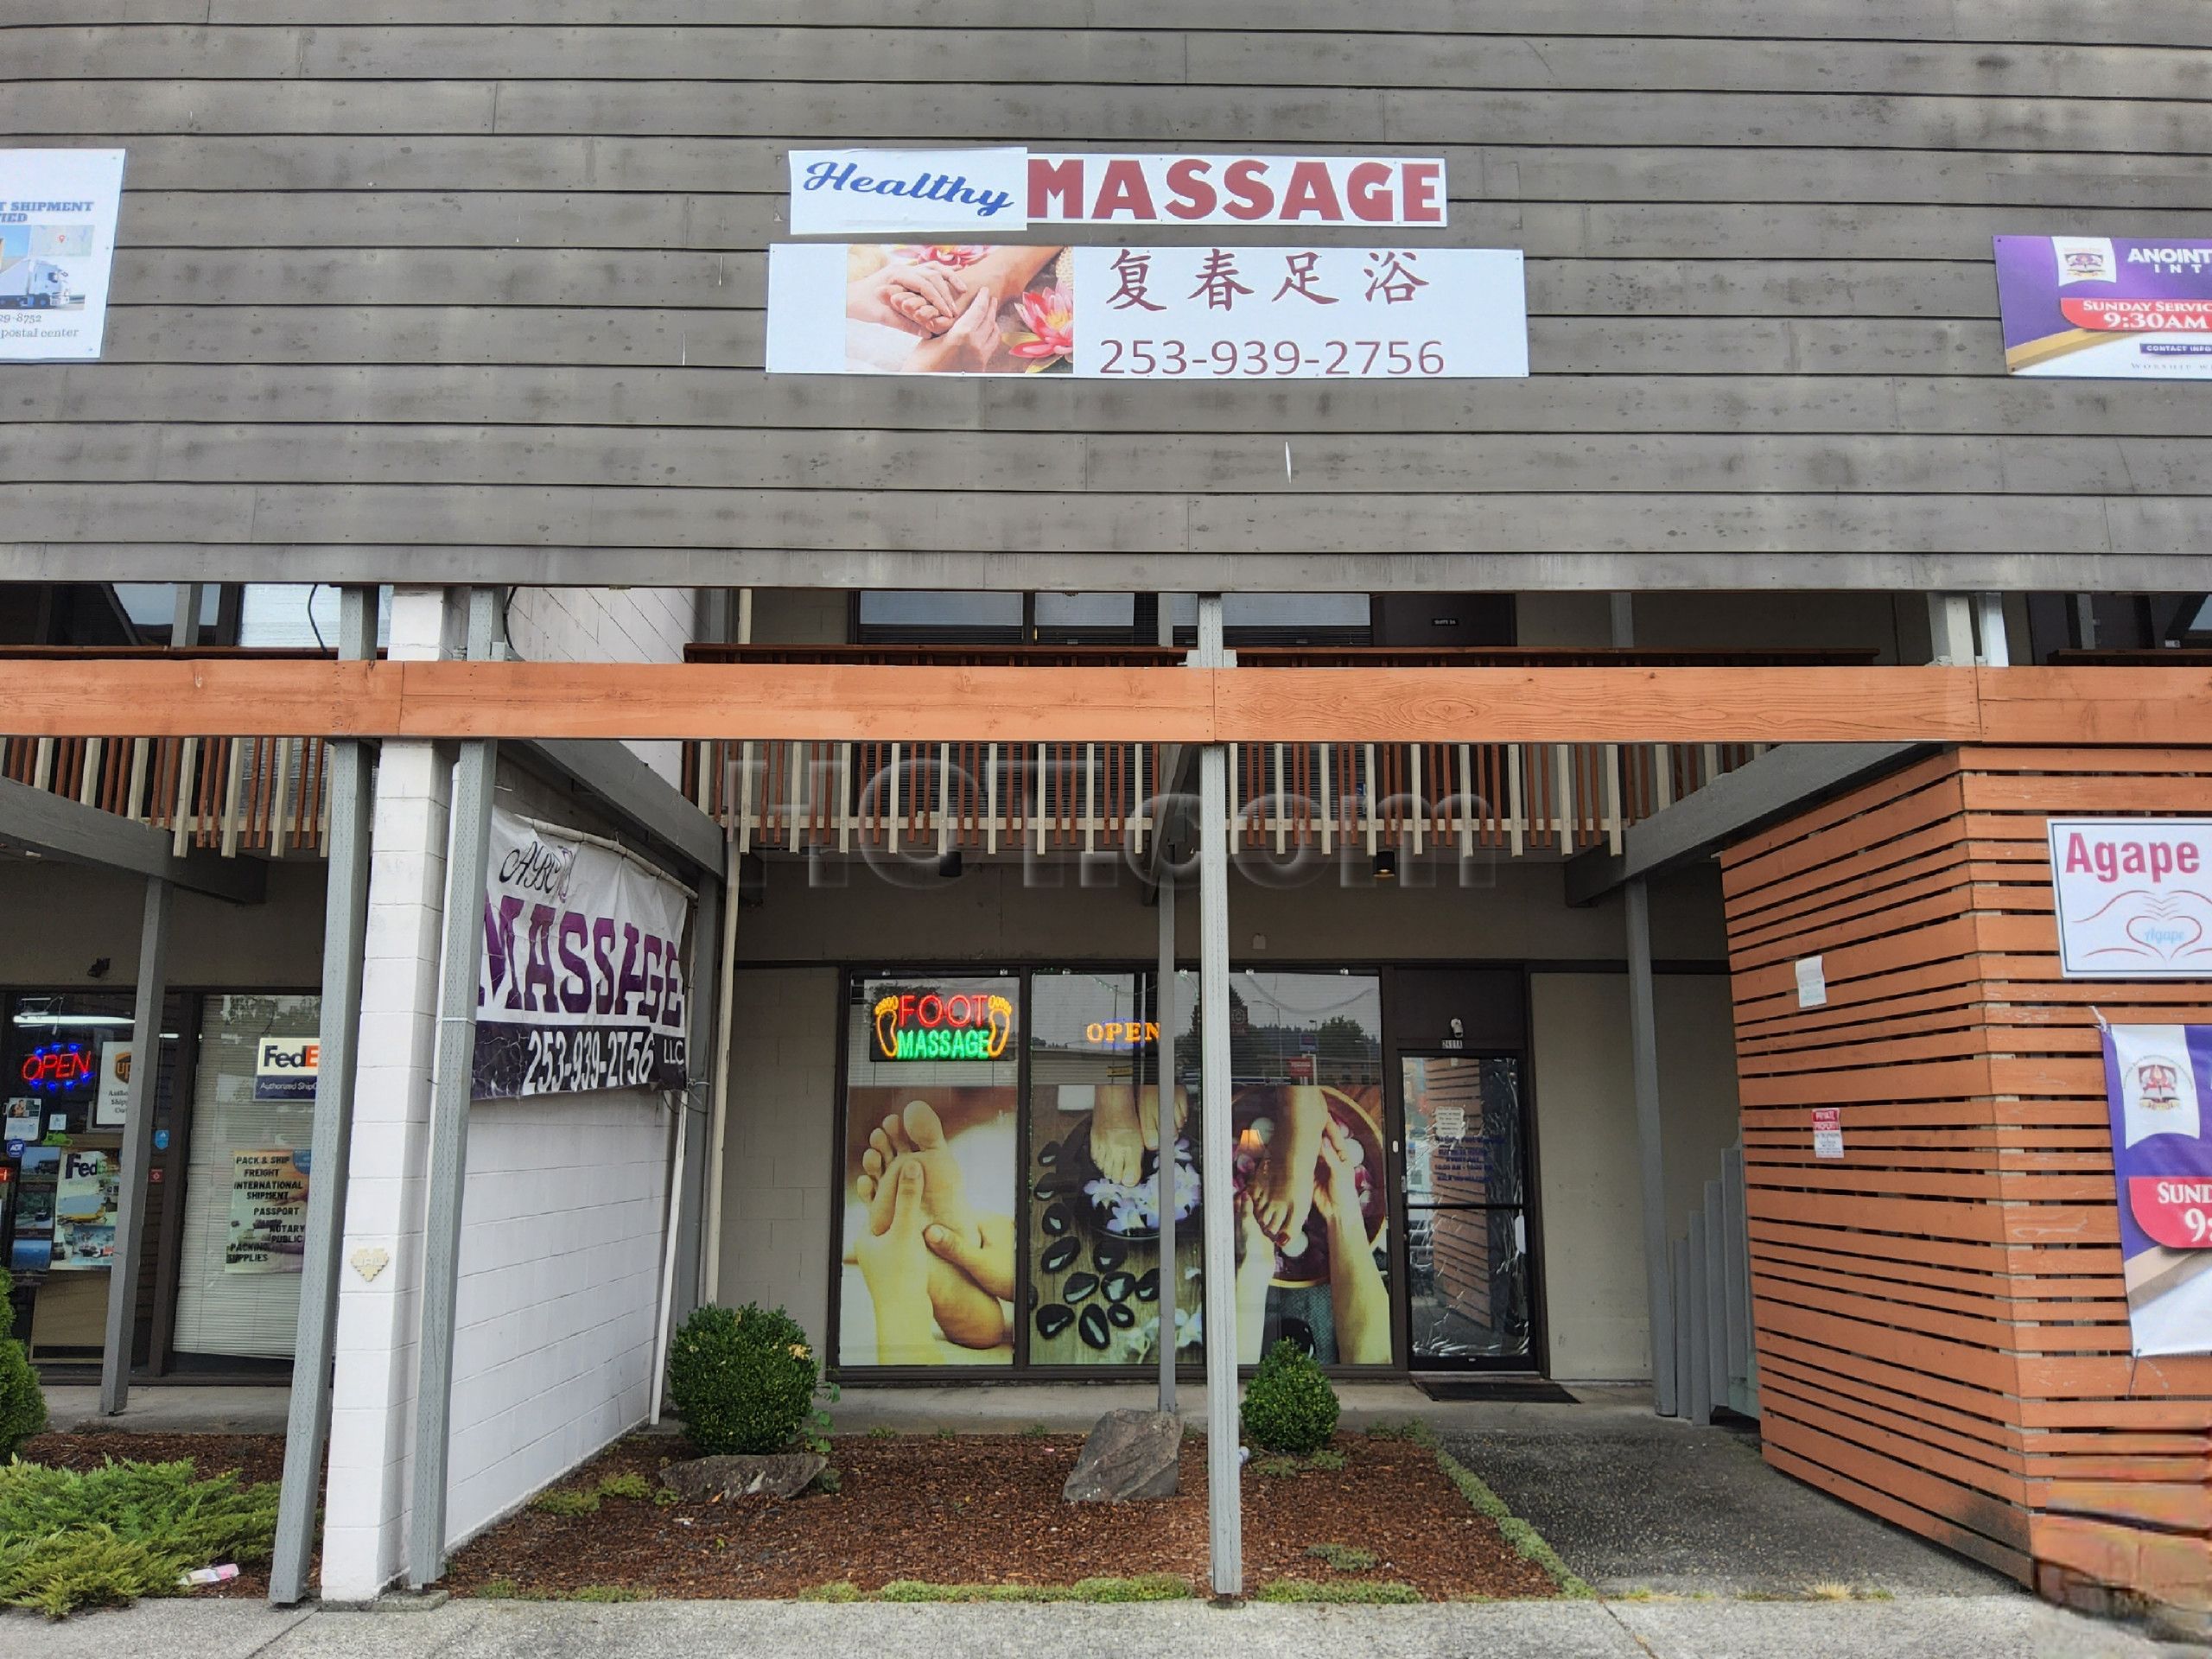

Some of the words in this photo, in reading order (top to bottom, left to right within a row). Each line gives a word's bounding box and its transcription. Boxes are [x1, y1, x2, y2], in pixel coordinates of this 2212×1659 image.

[803, 162, 1015, 216] Healthy
[1027, 158, 1441, 222] MASSAGE
[10, 201, 94, 212] SHIPMENT
[1105, 248, 1430, 312] 复春足浴
[2082, 300, 2152, 311] SUNDAY
[2103, 312, 2209, 329] 9:30AM
[0, 328, 38, 339] postal
[41, 328, 79, 338] center
[1100, 339, 1445, 375] 253-939-2756
[2065, 832, 2201, 883] Agape
[2144, 927, 2185, 944] Agape
[898, 995, 988, 1028] FOOT
[1085, 1022, 1161, 1044] OPEN
[896, 1029, 989, 1059] MASSAGE
[22, 1050, 92, 1081] OPEN
[521, 1030, 656, 1096] 253-939-2756
[664, 1039, 685, 1065] LLC
[236, 1156, 259, 1165] PACK
[244, 1168, 281, 1178] FREIGHT
[233, 1180, 303, 1190] INTERNATIONAL
[246, 1192, 289, 1200] SHIPMENT
[253, 1207, 300, 1216] PASSPORT
[270, 1224, 305, 1233] NOTARY
[270, 1235, 304, 1243] PUBLIC
